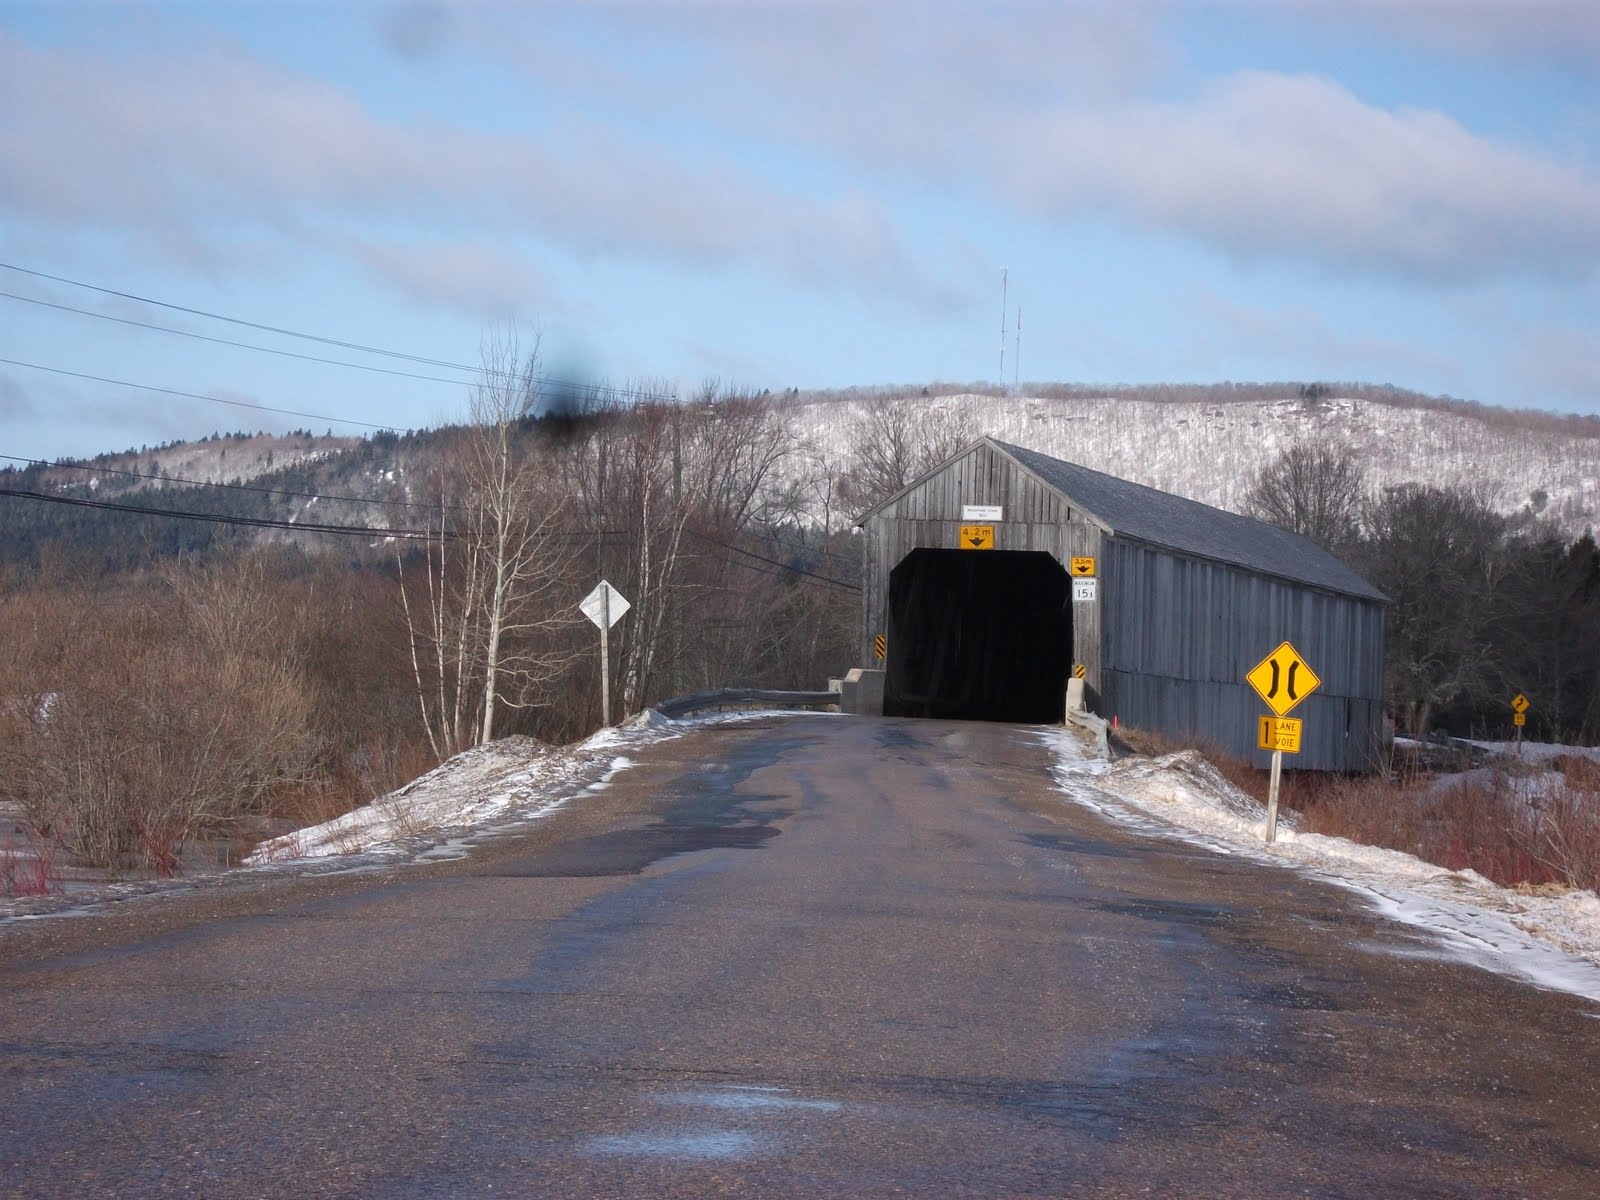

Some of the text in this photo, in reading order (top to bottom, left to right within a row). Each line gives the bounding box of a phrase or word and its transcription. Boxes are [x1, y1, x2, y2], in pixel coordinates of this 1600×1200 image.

[1264, 721, 1269, 744] 1
[1274, 722, 1296, 732] LANE
[1275, 737, 1294, 748] VOIE
